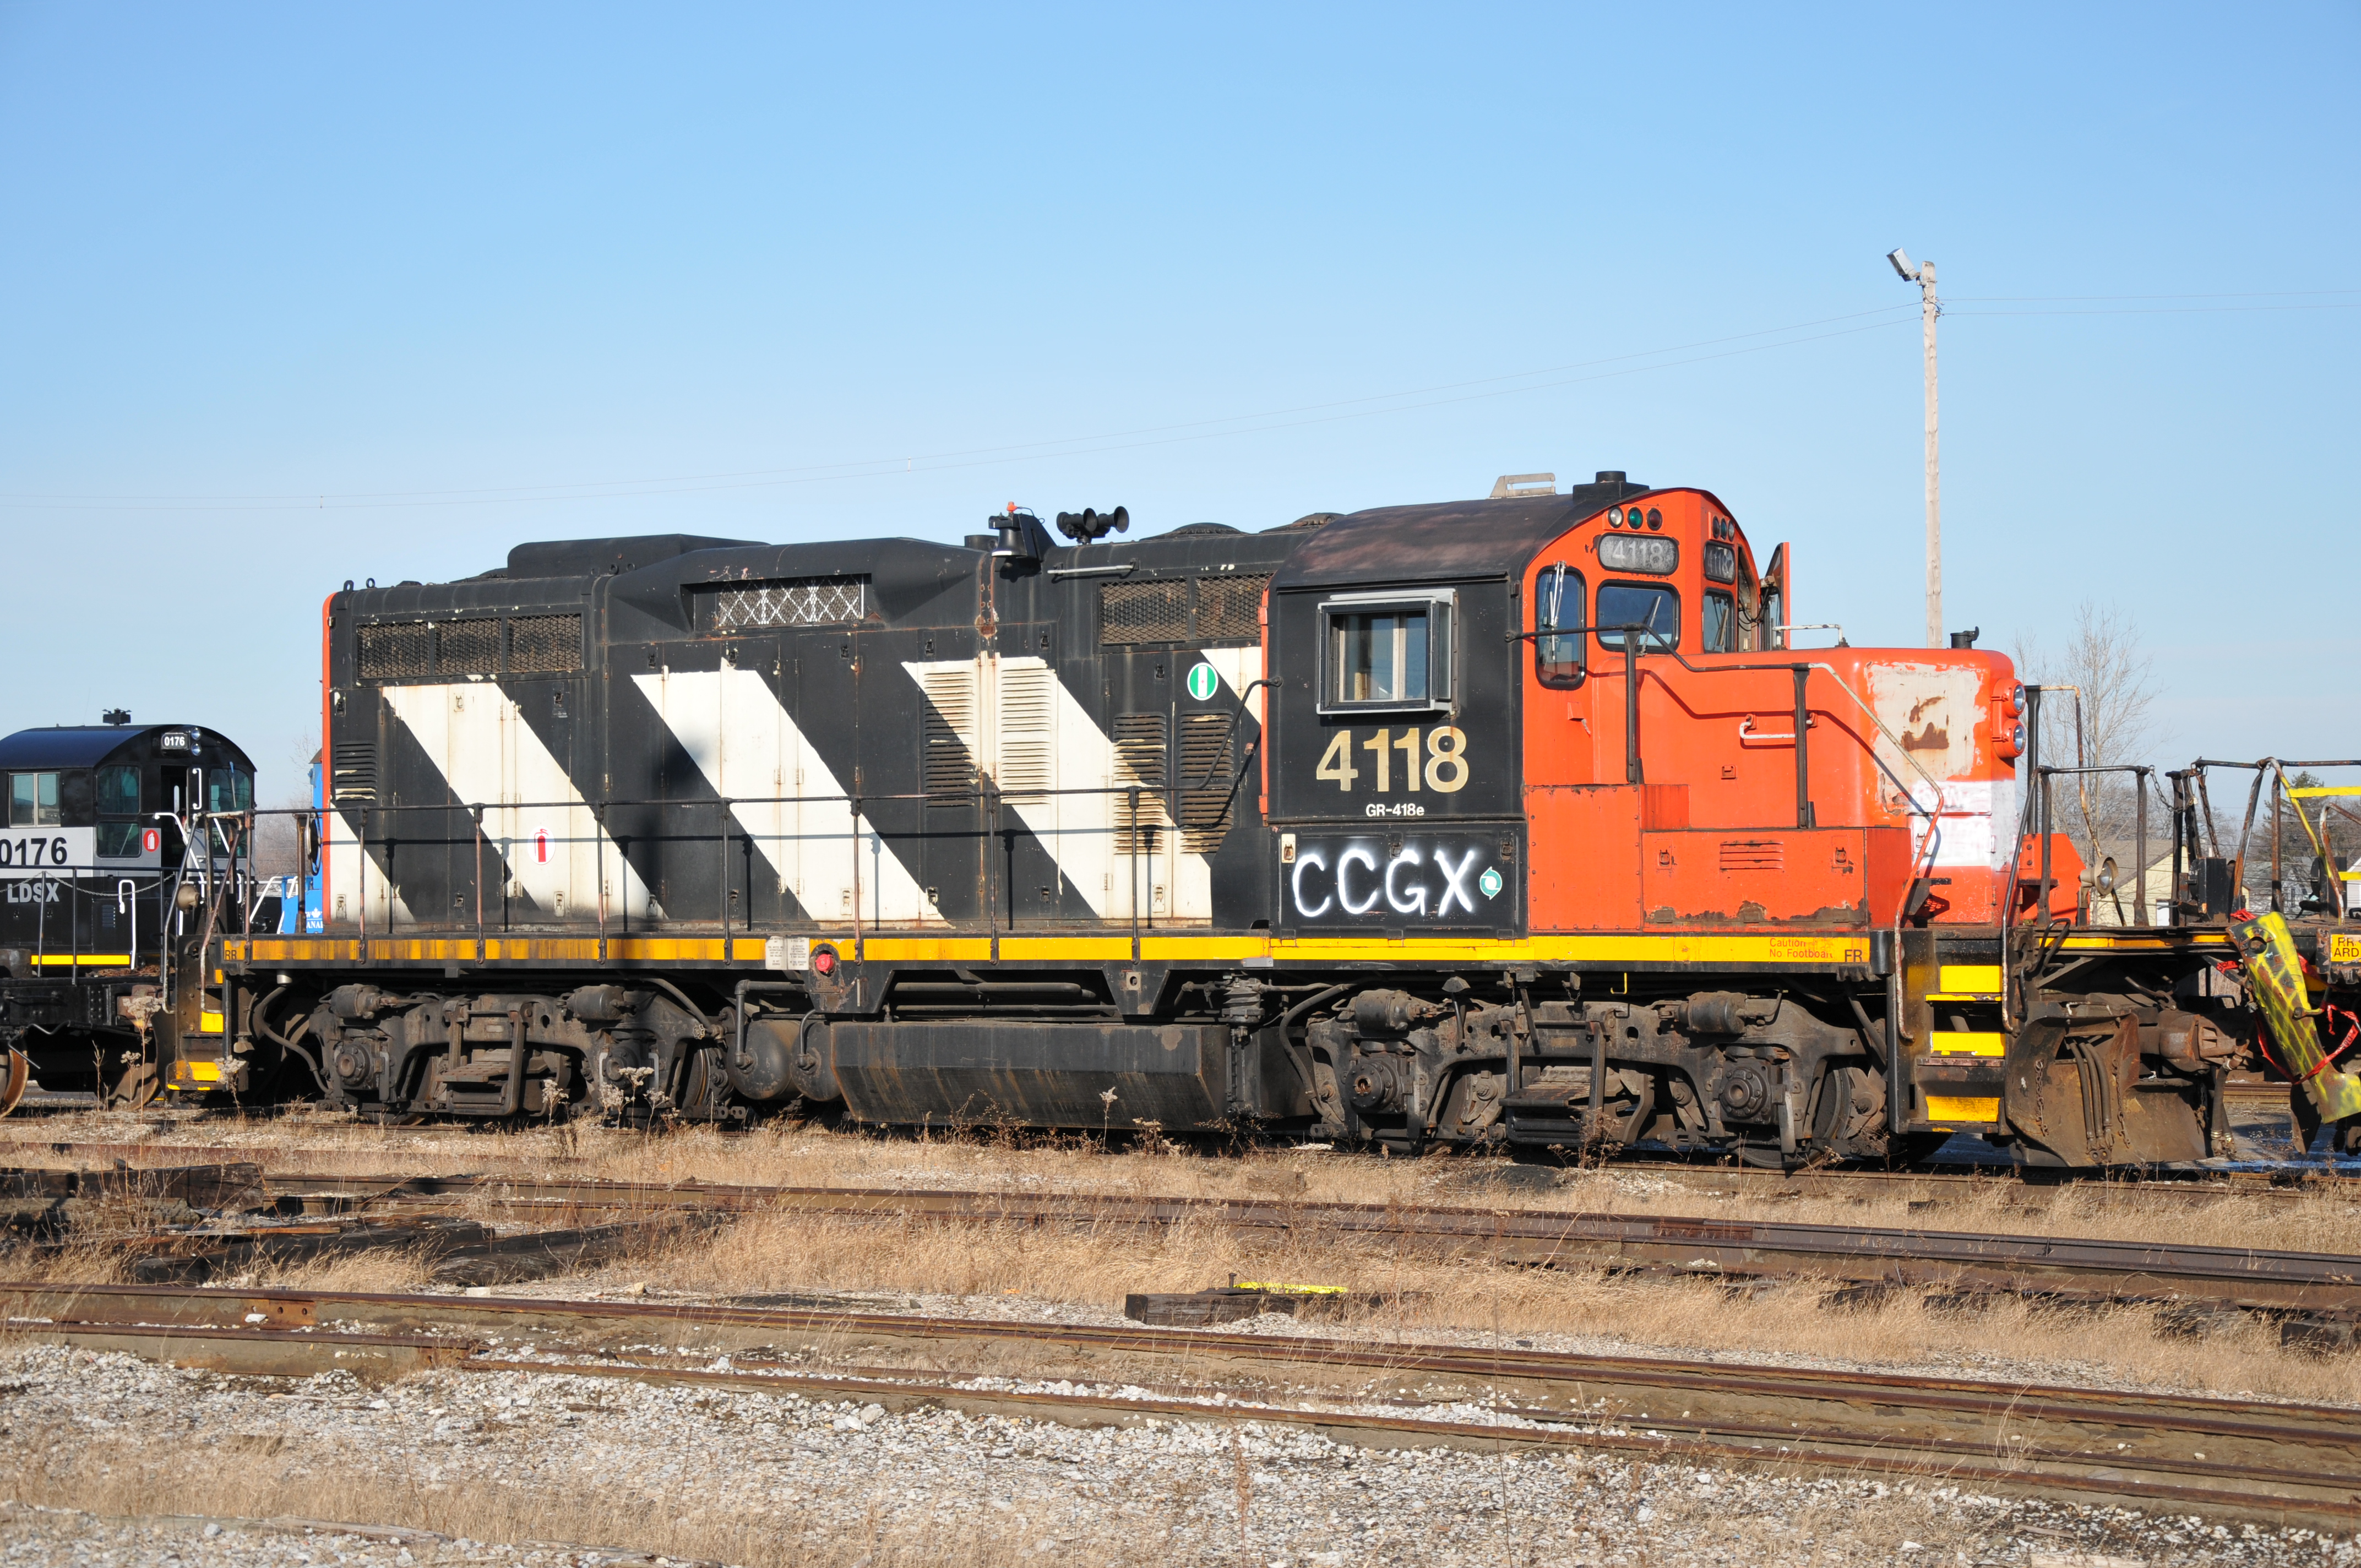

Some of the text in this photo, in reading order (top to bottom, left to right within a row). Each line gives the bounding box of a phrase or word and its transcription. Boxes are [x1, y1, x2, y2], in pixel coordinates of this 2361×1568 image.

[1612, 540, 1663, 568] 4118
[164, 736, 185, 747] 0176
[1316, 726, 1468, 793] 4118
[1366, 803, 1425, 818] GR-418e
[0, 837, 68, 865] 0176
[1292, 847, 1476, 917] CCGX
[7, 883, 60, 903] LDSX
[1769, 938, 1806, 948] Caution
[225, 950, 237, 960] RR
[1769, 949, 1782, 957] No
[1845, 949, 1863, 962] FR
[2333, 948, 2359, 957] ARD
